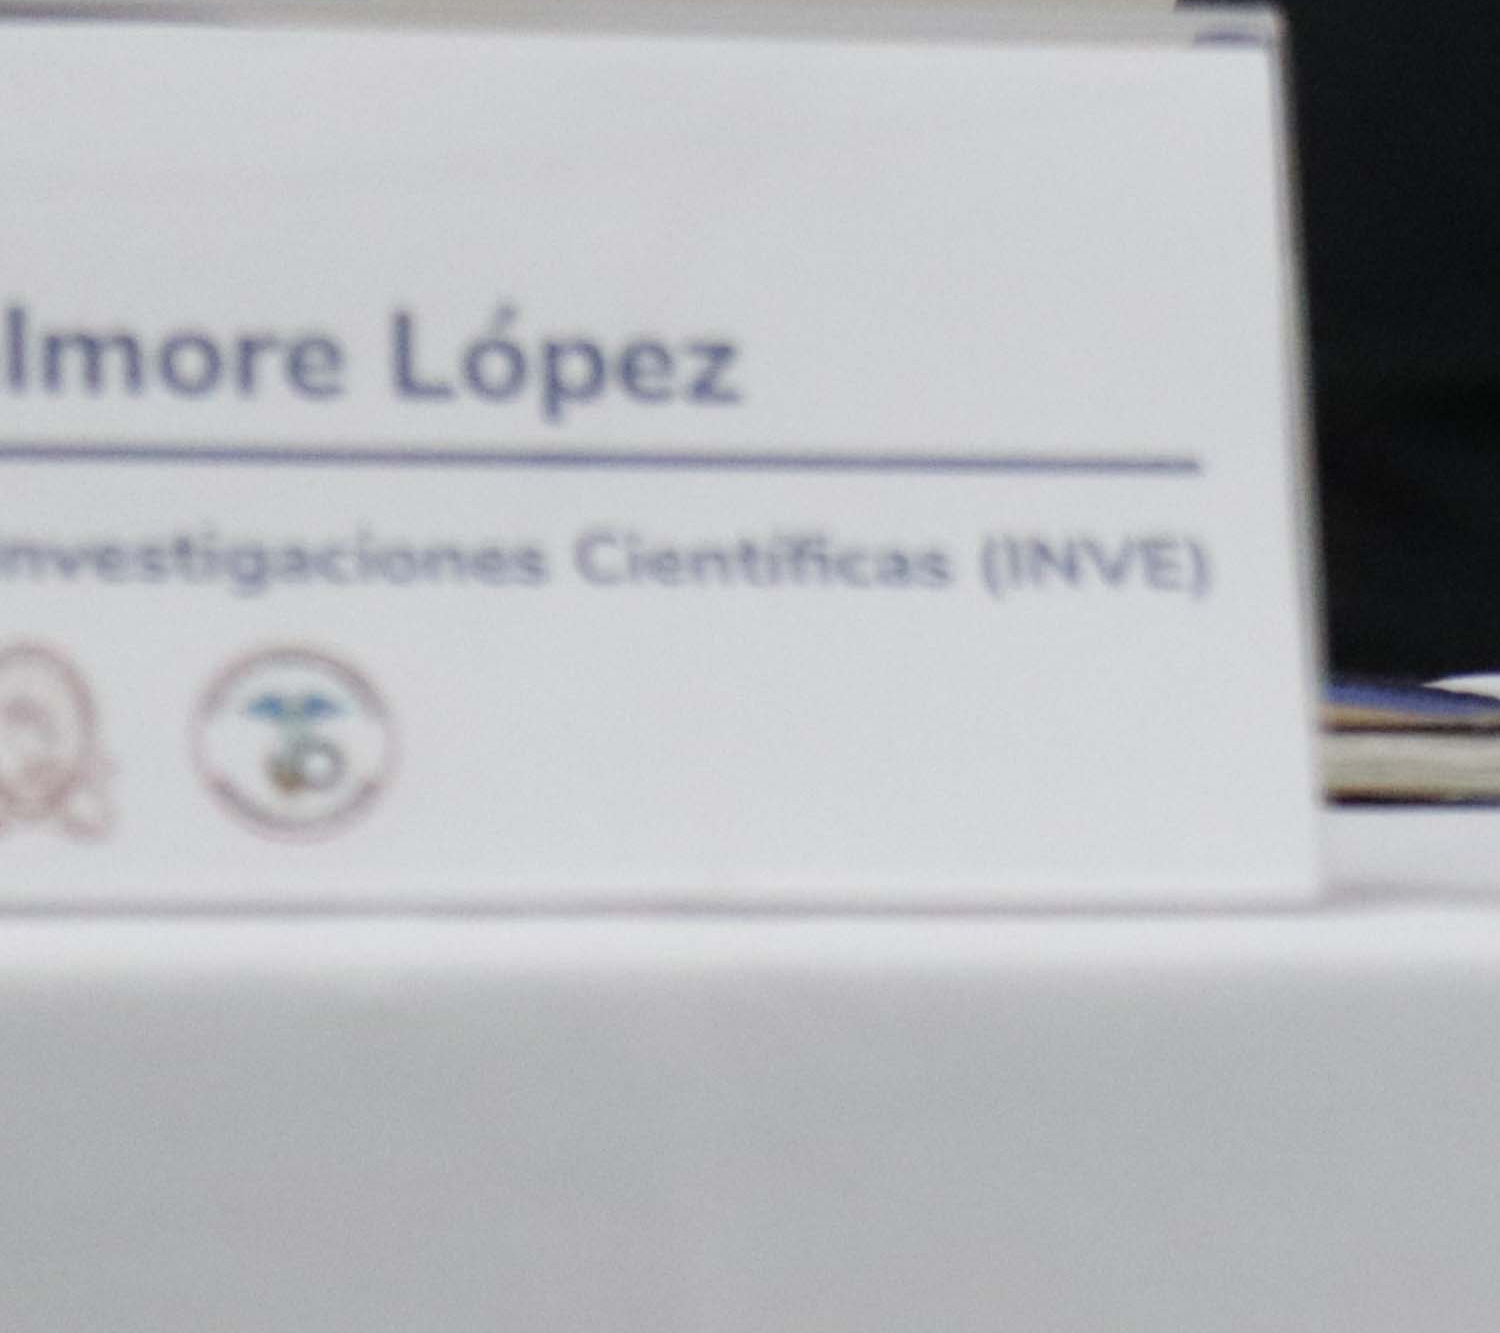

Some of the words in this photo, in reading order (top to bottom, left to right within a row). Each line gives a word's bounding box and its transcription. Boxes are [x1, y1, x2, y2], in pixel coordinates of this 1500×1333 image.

[388, 303, 742, 425] López
[571, 525, 956, 592] Científicas
[977, 532, 1213, 600] (INVE)
